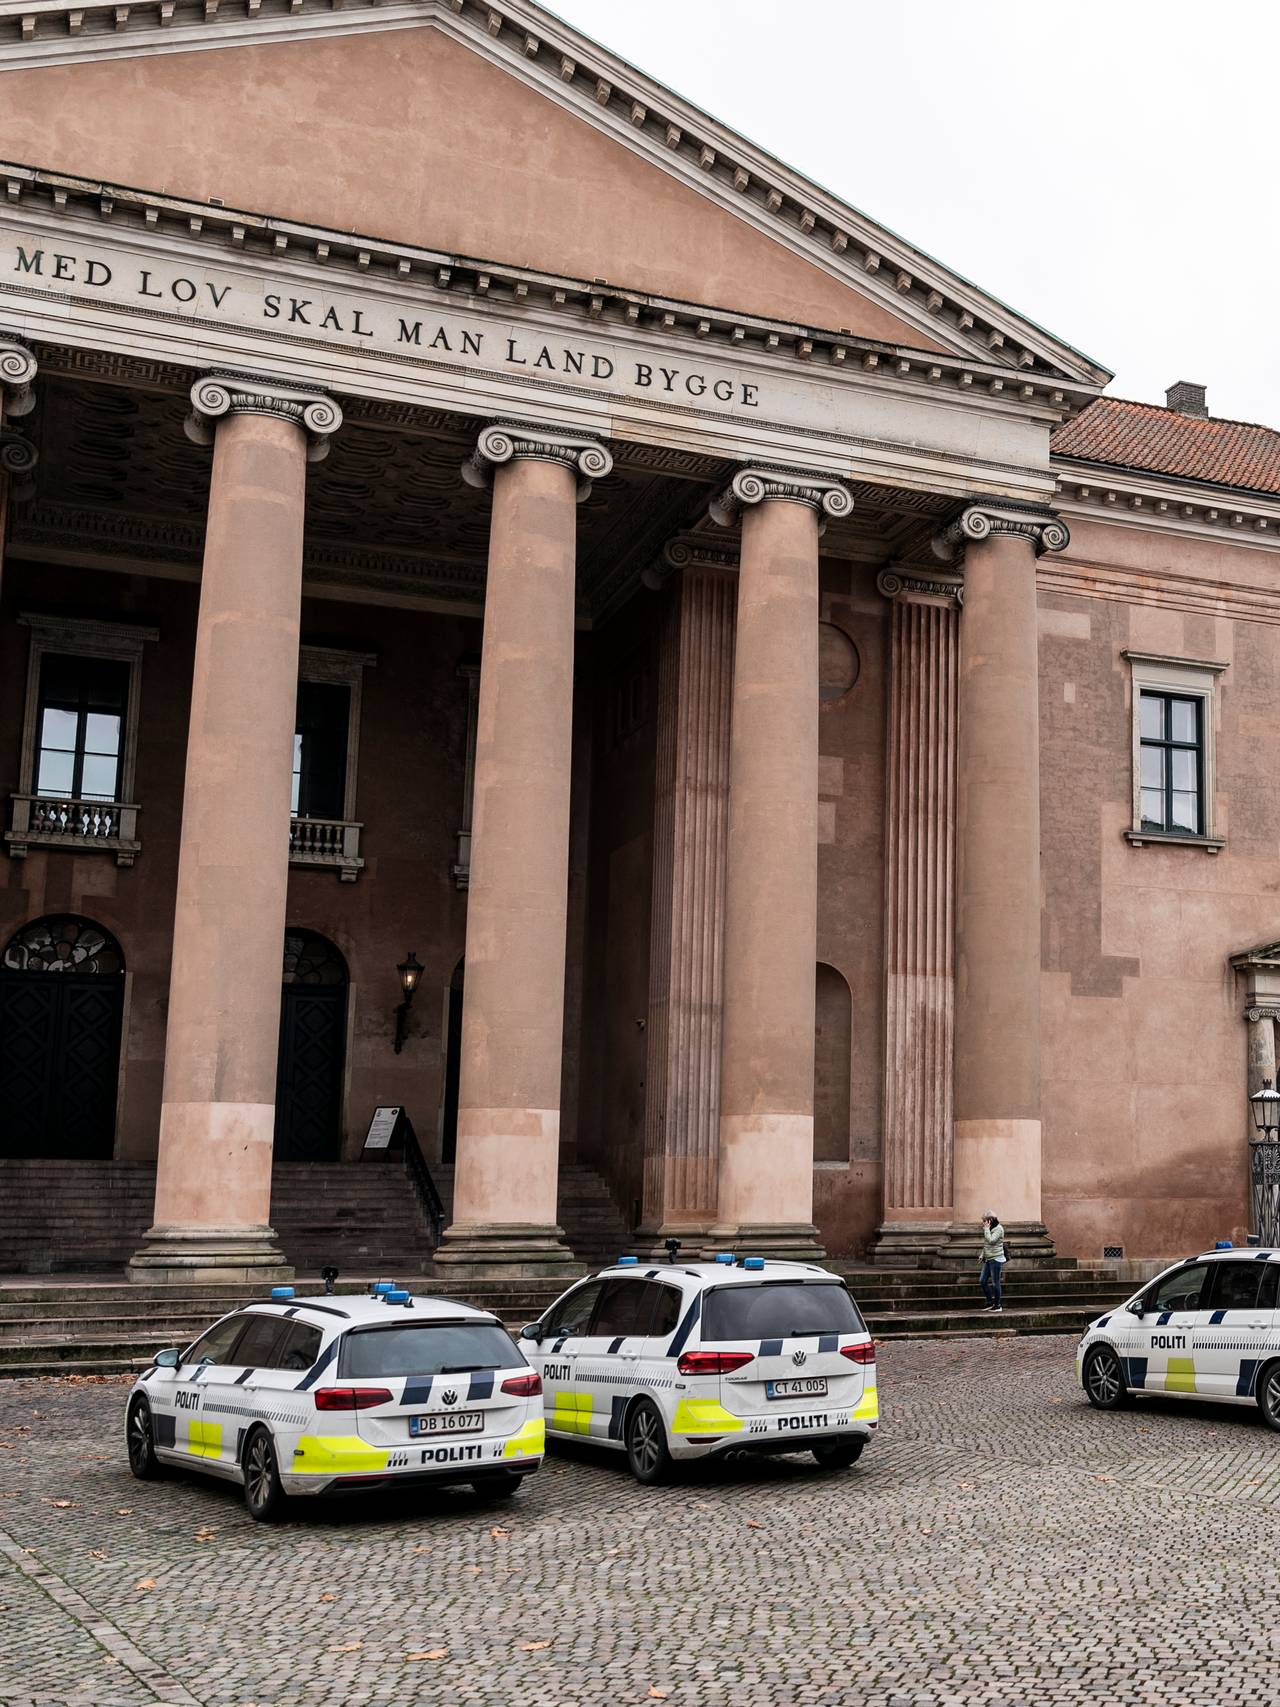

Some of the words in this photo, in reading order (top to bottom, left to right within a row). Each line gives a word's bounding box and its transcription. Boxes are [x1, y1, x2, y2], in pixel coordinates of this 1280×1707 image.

[14, 246, 112, 287] MED
[138, 270, 232, 308] LOV
[263, 294, 374, 337] SKAL
[397, 318, 484, 356] MAN
[505, 339, 614, 379] LAND
[634, 363, 759, 407] BYGGE
[1151, 1335, 1186, 1349] POLITI
[543, 1364, 571, 1381] POLITI
[774, 1382, 789, 1394] CT
[791, 1381, 803, 1393] 41
[806, 1380, 825, 1392] 005
[174, 1390, 201, 1411] POLITI
[420, 1417, 437, 1431] DB
[441, 1415, 455, 1429] 16
[458, 1413, 481, 1428] 077
[777, 1414, 828, 1431] POLITI
[421, 1445, 482, 1464] POLITI
